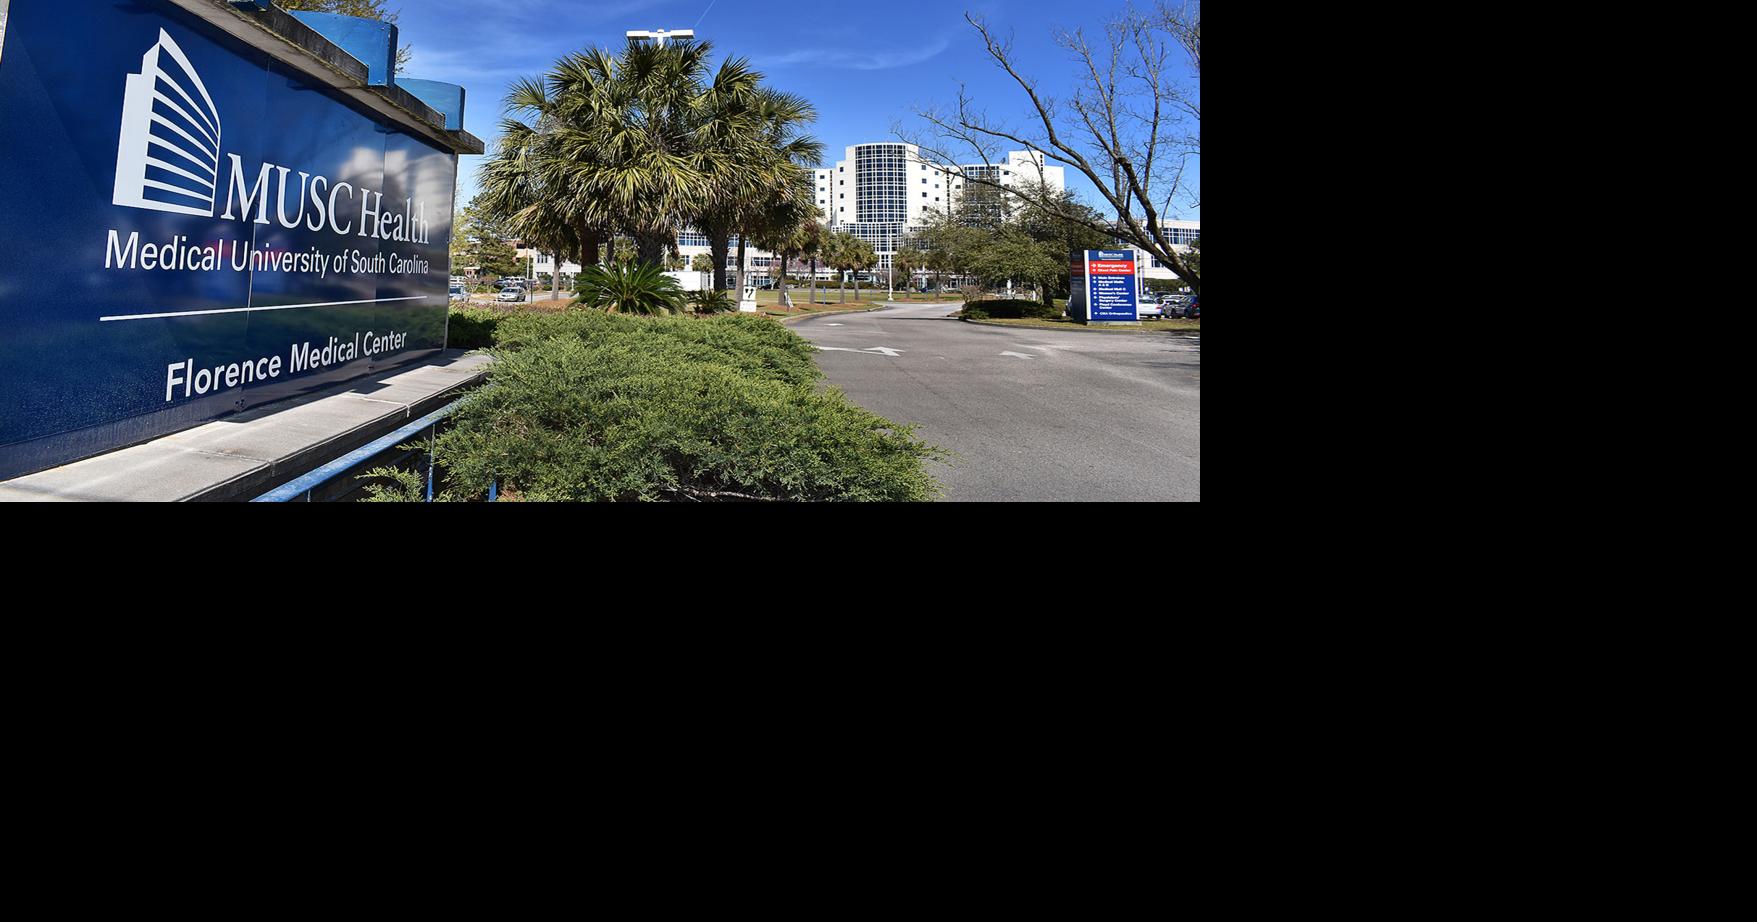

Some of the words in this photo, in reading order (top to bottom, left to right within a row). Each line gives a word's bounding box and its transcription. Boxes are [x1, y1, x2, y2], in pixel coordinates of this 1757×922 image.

[220, 152, 353, 235] MUSC
[357, 188, 430, 244] Health
[104, 229, 223, 272] Medical
[230, 239, 330, 279] University
[333, 249, 348, 274] of
[350, 250, 386, 274] South
[389, 252, 429, 274] Carolina
[166, 355, 281, 401] Florence
[290, 331, 359, 373] Medical
[363, 330, 407, 356] Center
